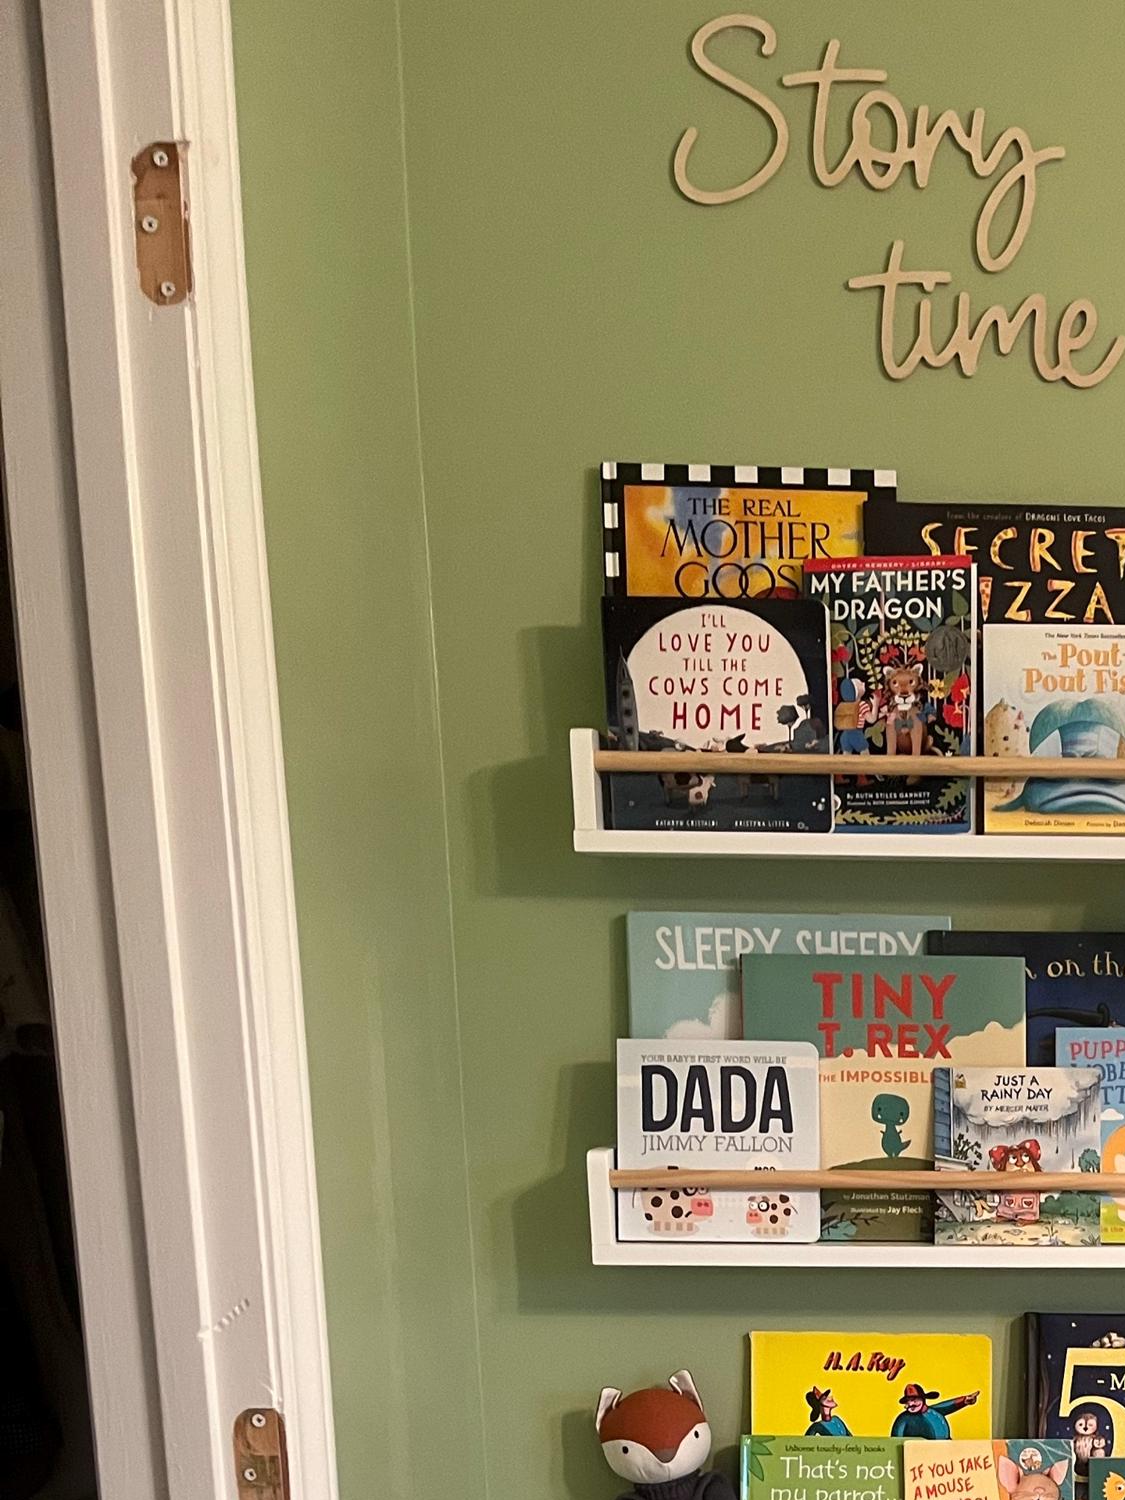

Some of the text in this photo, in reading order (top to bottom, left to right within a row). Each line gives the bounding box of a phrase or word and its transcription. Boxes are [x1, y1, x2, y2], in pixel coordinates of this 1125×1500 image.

[674, 14, 1066, 272] Story
[687, 498, 802, 517] THE REAL
[1025, 512, 1060, 522] DRAGONS
[1063, 513, 1082, 523] LOVE
[1084, 514, 1107, 523] TACOS
[660, 518, 833, 560] MOTHER
[675, 561, 804, 600] GOOS
[810, 569, 966, 595] MY FATHER'S
[834, 596, 942, 621] DRAGON
[979, 576, 1115, 625] IZZA
[701, 613, 727, 628] I'LL
[659, 632, 770, 653] LOVE YOU
[683, 657, 747, 672] TILL THE
[1041, 651, 1057, 661] The
[649, 676, 783, 696] COWS COME
[1022, 668, 1088, 694] Pout
[673, 702, 762, 730] HOME
[654, 925, 782, 971] SLEEPY
[1047, 958, 1086, 978] on
[812, 970, 957, 1020] TINY
[817, 1022, 953, 1058] T. REX
[641, 1054, 788, 1064] YOUR BABY'S FIRST WORD WILL BE
[994, 1075, 1040, 1087] JUST A
[641, 1064, 794, 1133] DADA
[980, 1088, 1053, 1102] RAINY DAY
[641, 1135, 795, 1155] JIMMY FALLON
[887, 1206, 923, 1215] Jay Fleck
[823, 1351, 906, 1381] H. A. Rey
[780, 1455, 896, 1480] That's not
[910, 1455, 993, 1482] IF YOU TAKE
[914, 1477, 974, 1500] A MOUSE
